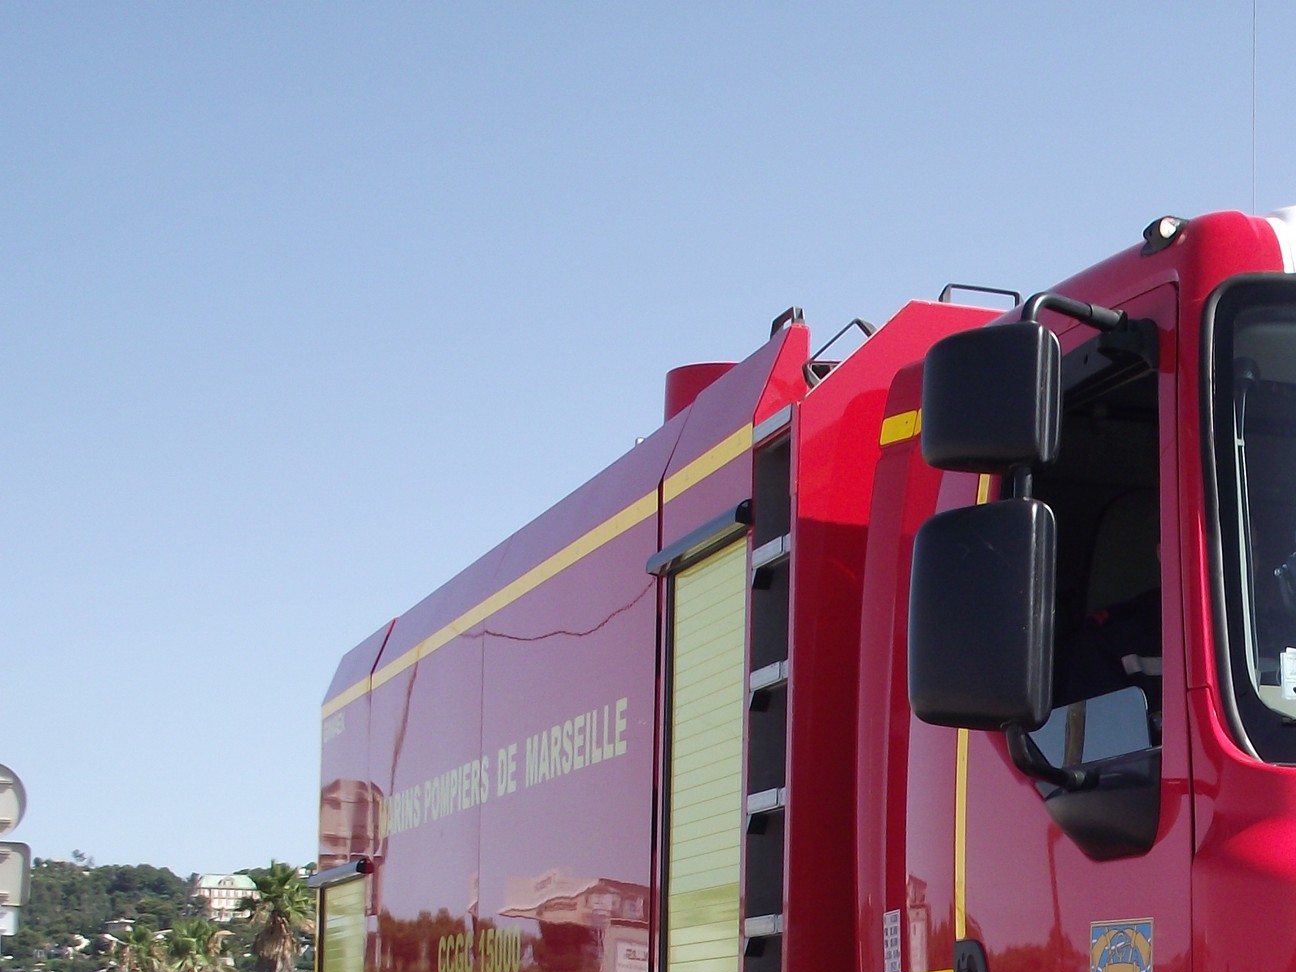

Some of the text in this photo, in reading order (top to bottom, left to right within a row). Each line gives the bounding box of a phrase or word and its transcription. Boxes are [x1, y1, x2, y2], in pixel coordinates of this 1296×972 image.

[378, 697, 628, 840] MARINS POMPIERS DE MARSEILLE
